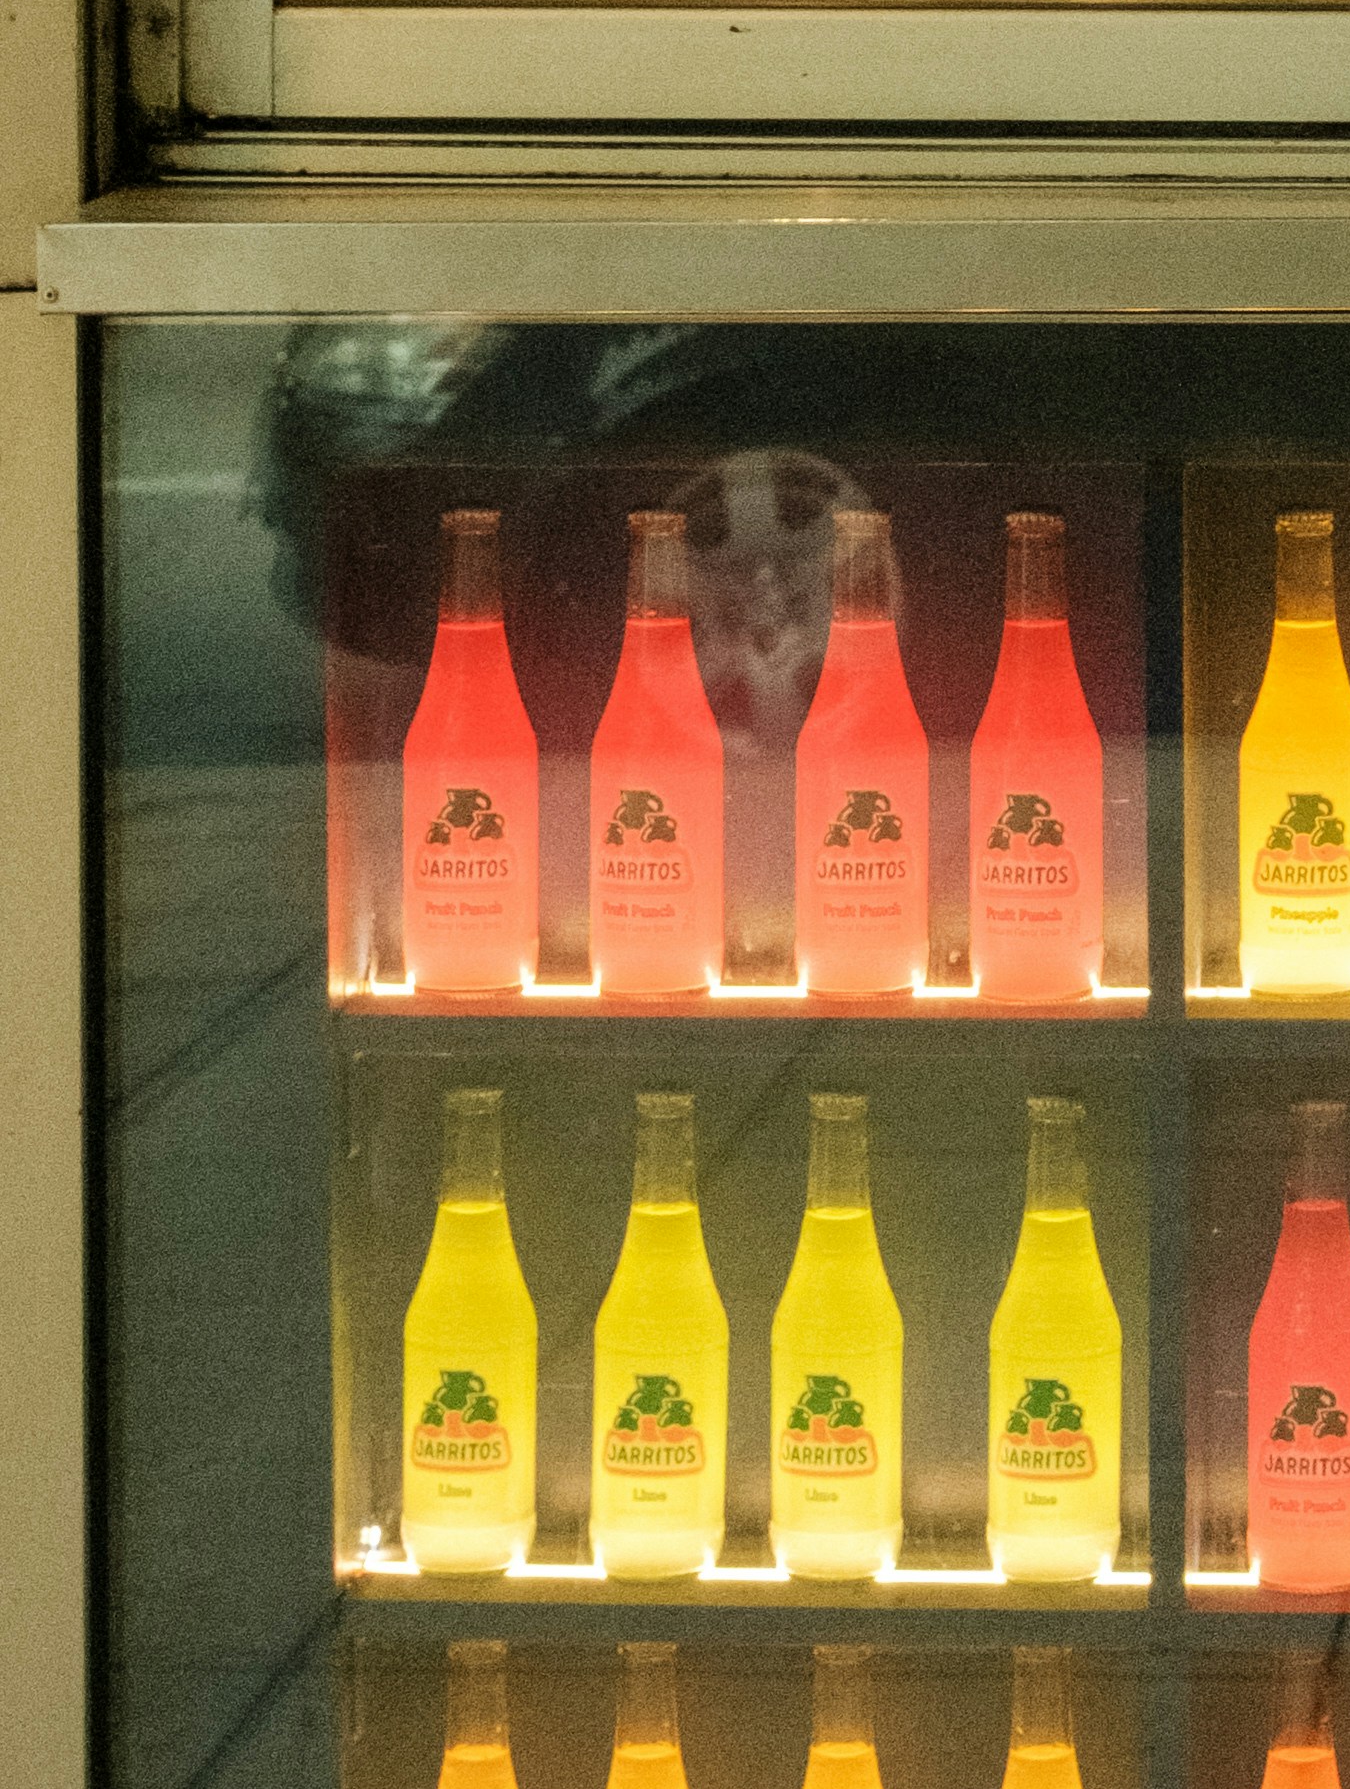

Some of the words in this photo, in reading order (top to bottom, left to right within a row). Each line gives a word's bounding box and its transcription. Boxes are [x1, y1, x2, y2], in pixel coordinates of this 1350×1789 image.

[420, 859, 508, 878] JARRITOS
[600, 860, 681, 880] JARRITOS
[818, 861, 905, 880] JARRITOS
[982, 866, 1068, 883] JARRITOS
[1261, 863, 1348, 883] JARRITOS
[1271, 907, 1339, 922] Pineapple
[416, 1441, 501, 1461] JARRITOS
[609, 1445, 695, 1465] JARRITOS
[783, 1446, 867, 1466] JARRITOS
[1002, 1449, 1086, 1469] JARRITOS
[1265, 1454, 1350, 1475] JARRITOS
